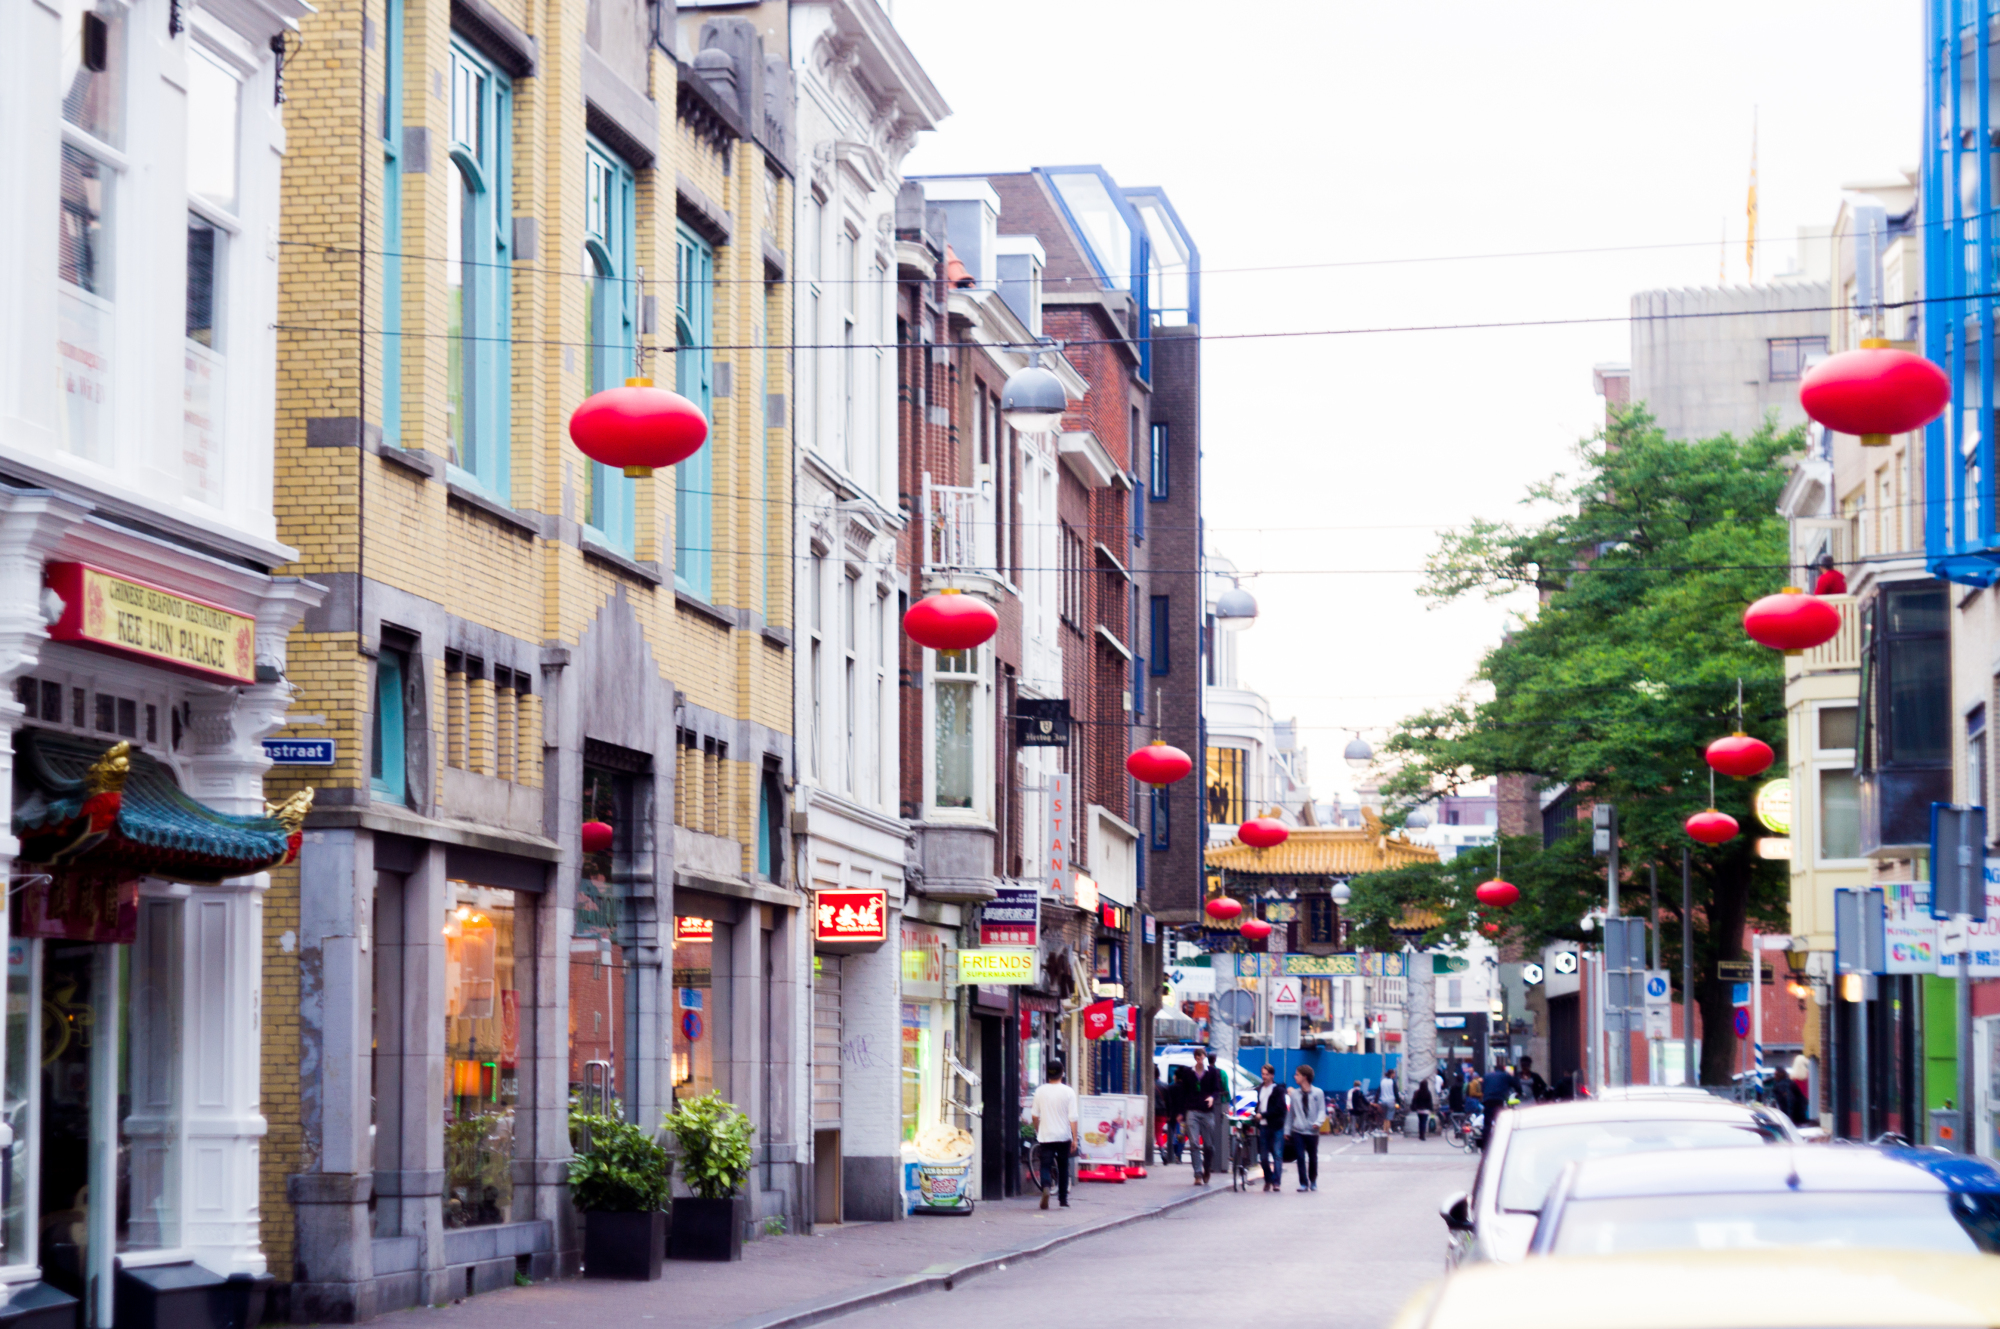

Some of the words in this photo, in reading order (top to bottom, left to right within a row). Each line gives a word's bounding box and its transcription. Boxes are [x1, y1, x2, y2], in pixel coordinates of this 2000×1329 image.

[109, 580, 144, 607] CHINESE
[147, 590, 182, 618] SEAFOOD
[185, 603, 232, 633] RESTAURANT
[117, 610, 143, 646] KEE
[148, 619, 174, 655] LUN
[179, 628, 225, 669] PALACE
[1051, 779, 1063, 891] ISTANA
[963, 956, 1032, 969] FRIENDS
